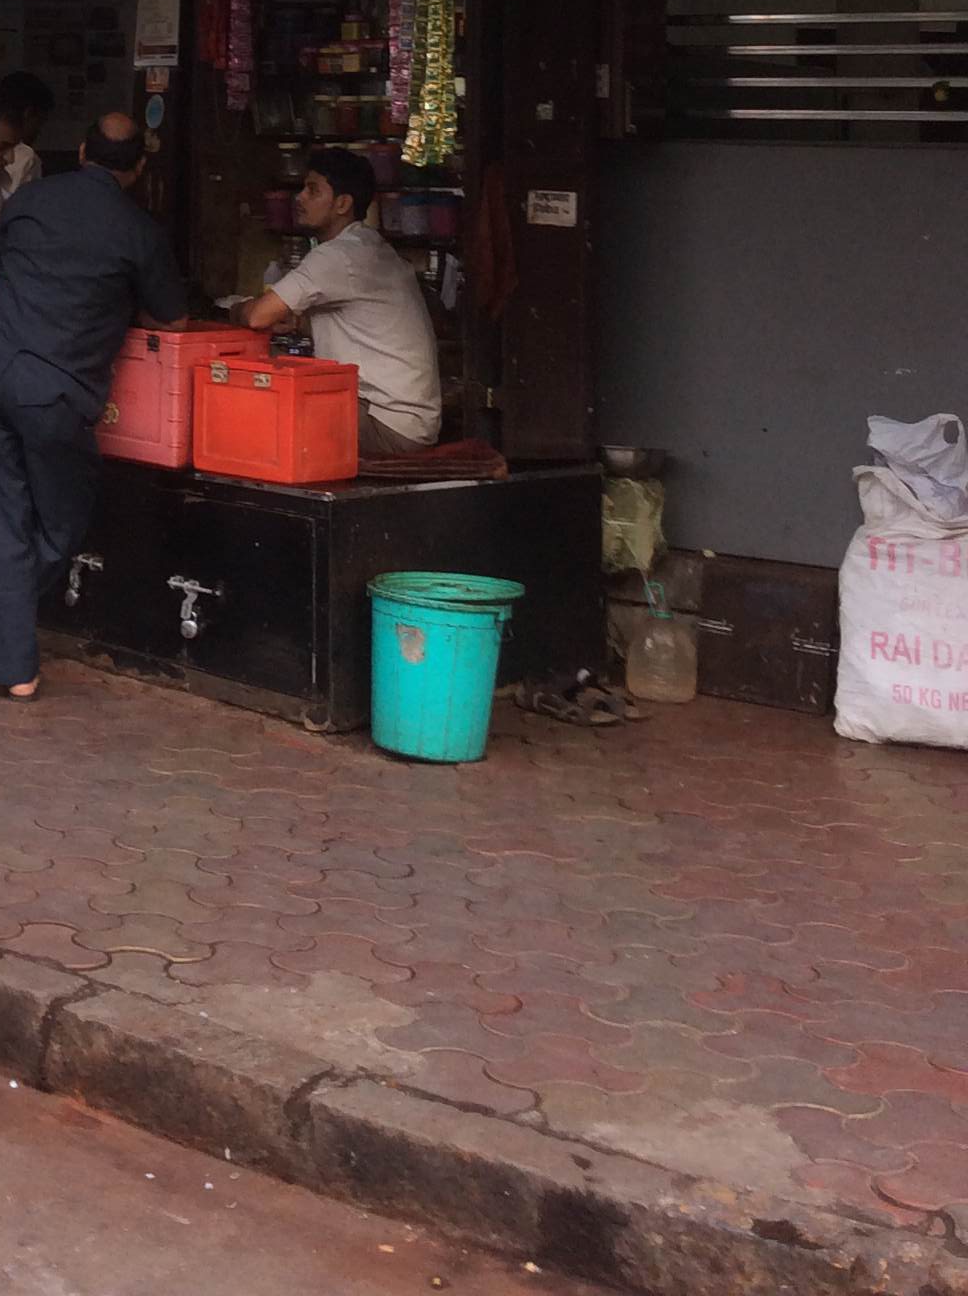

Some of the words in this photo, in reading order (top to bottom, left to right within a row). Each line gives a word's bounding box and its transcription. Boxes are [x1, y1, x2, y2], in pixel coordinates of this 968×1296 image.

[870, 630, 921, 666] RAI
[892, 683, 913, 705] 50
[918, 687, 942, 709] KG
